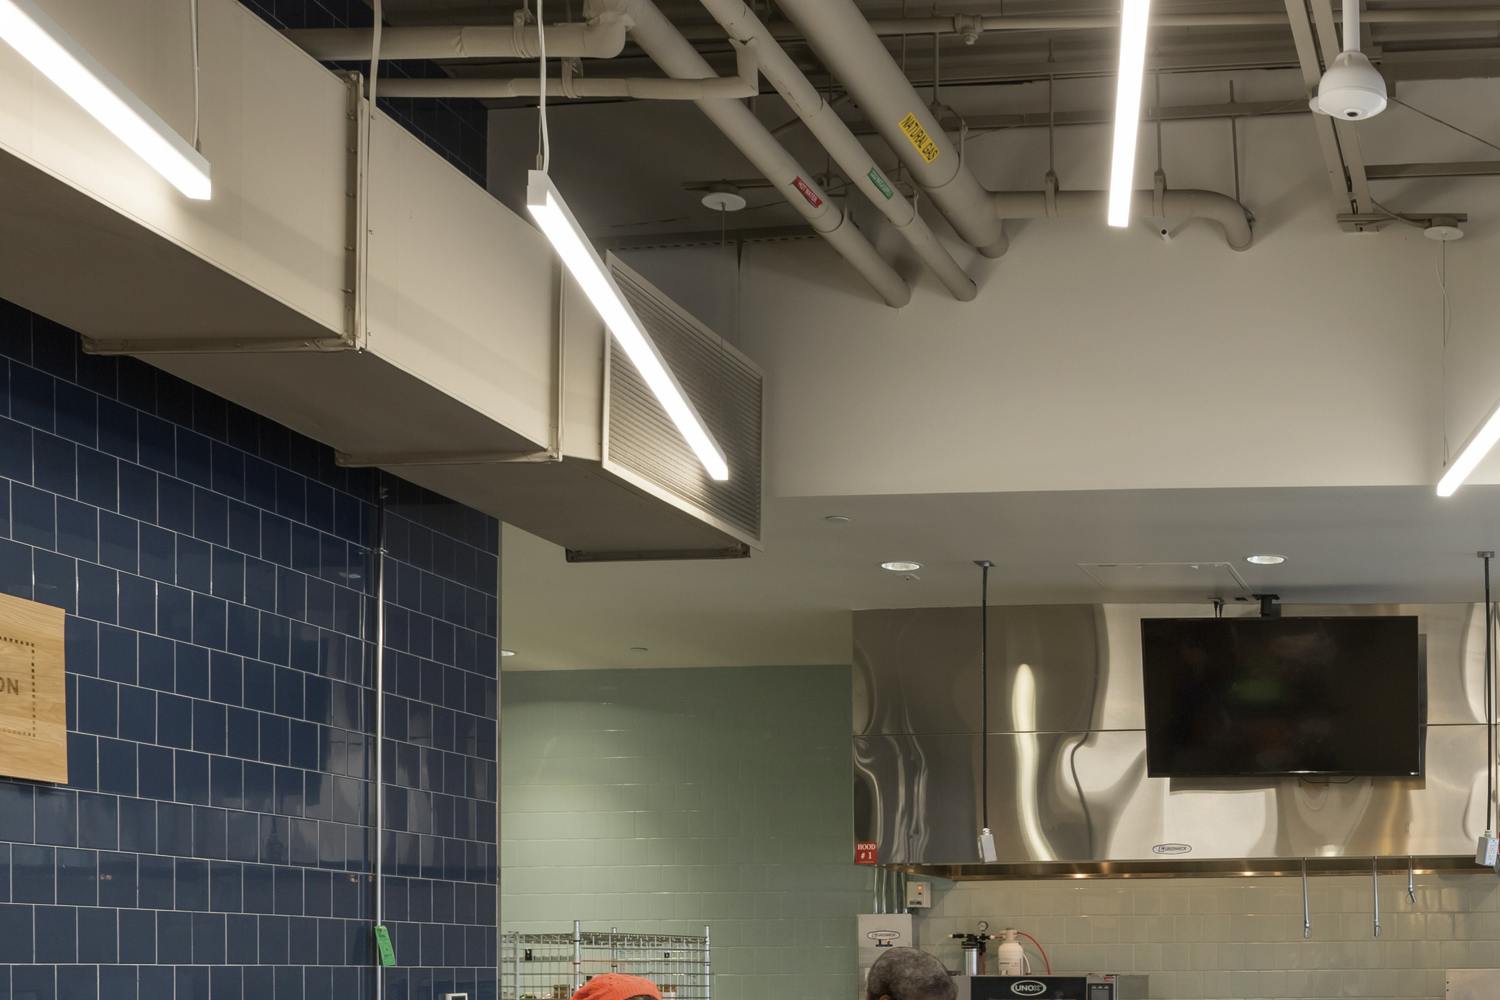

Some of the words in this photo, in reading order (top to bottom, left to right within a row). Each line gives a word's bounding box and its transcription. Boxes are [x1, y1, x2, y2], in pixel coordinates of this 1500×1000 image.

[903, 115, 929, 149] NATURAL
[922, 140, 938, 161] GAS
[857, 843, 876, 851] HOOD
[867, 852, 873, 860] 1
